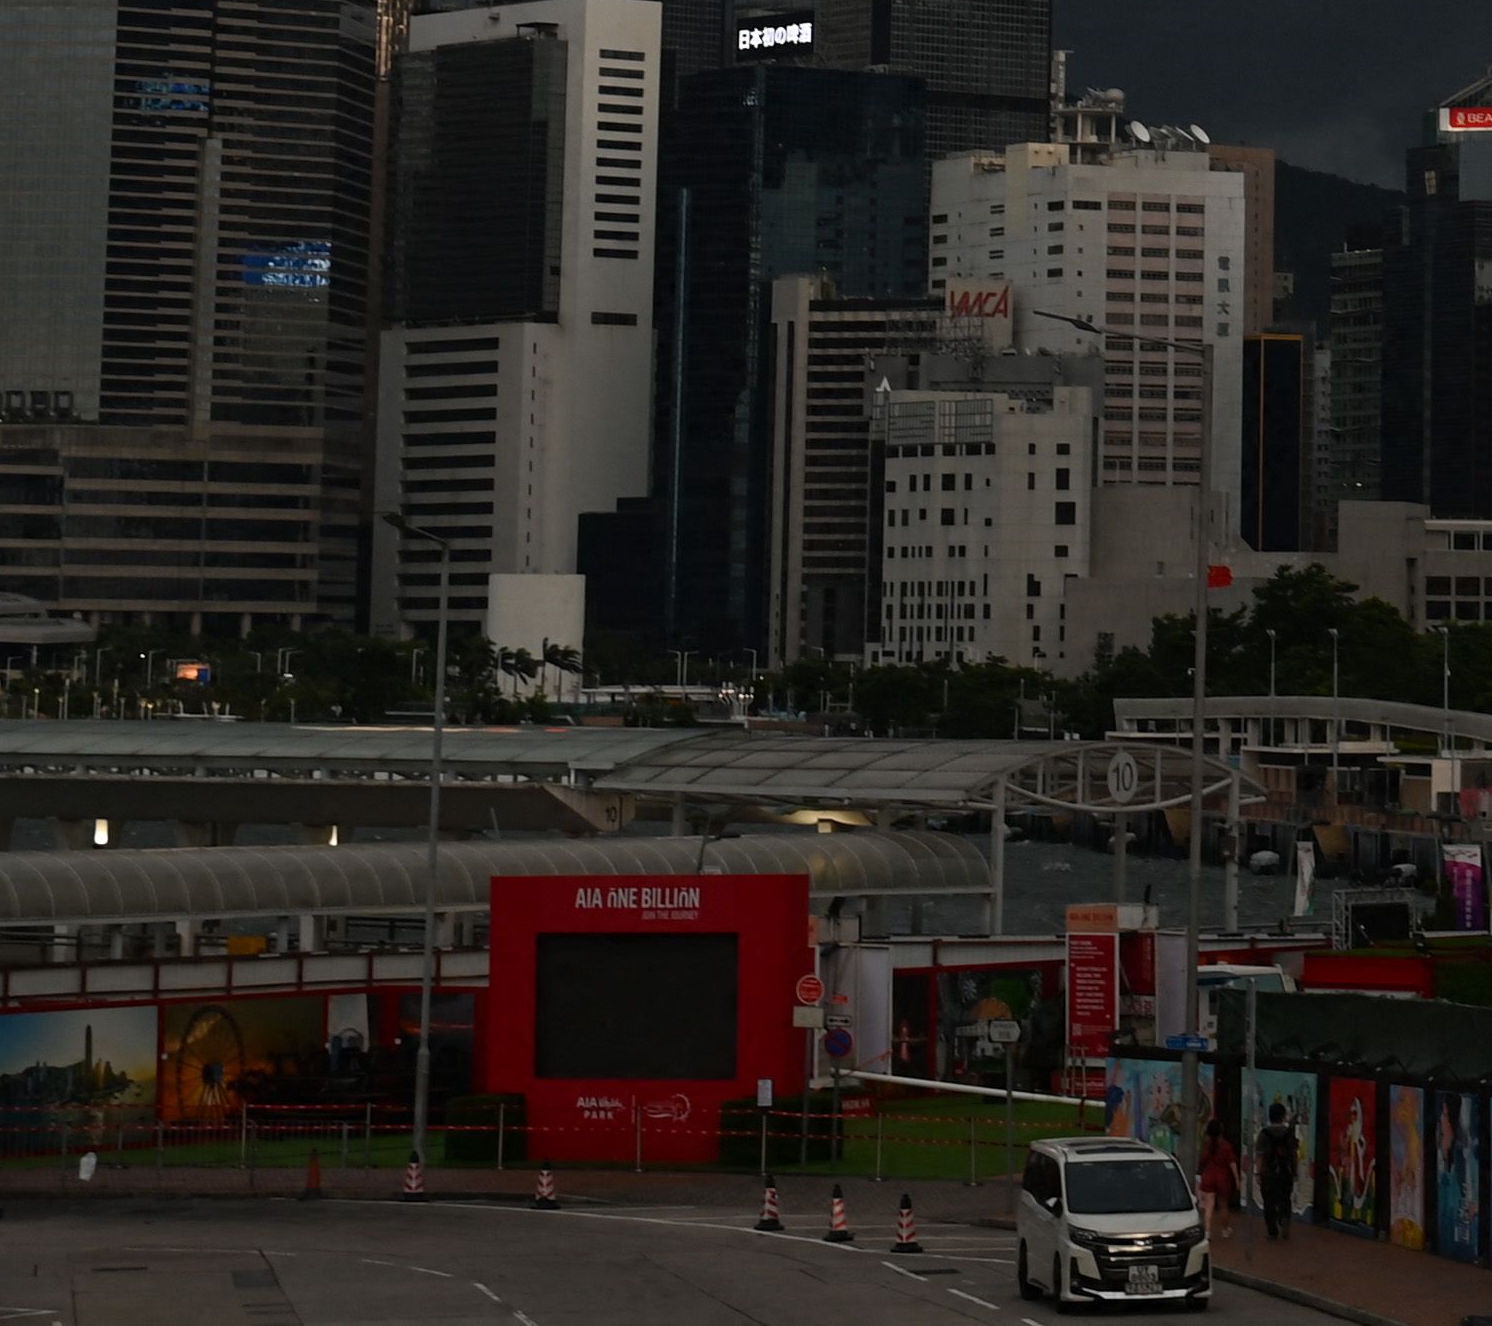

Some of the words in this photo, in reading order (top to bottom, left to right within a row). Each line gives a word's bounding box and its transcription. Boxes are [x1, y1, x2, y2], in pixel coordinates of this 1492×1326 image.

[1467, 112, 1492, 123] BEA
[950, 286, 1009, 320] YMCA
[1112, 762, 1133, 791] 10
[606, 806, 617, 822] 10
[574, 887, 603, 909] AIA
[576, 1096, 598, 1108] AIA
[583, 1110, 614, 1120] PARK
